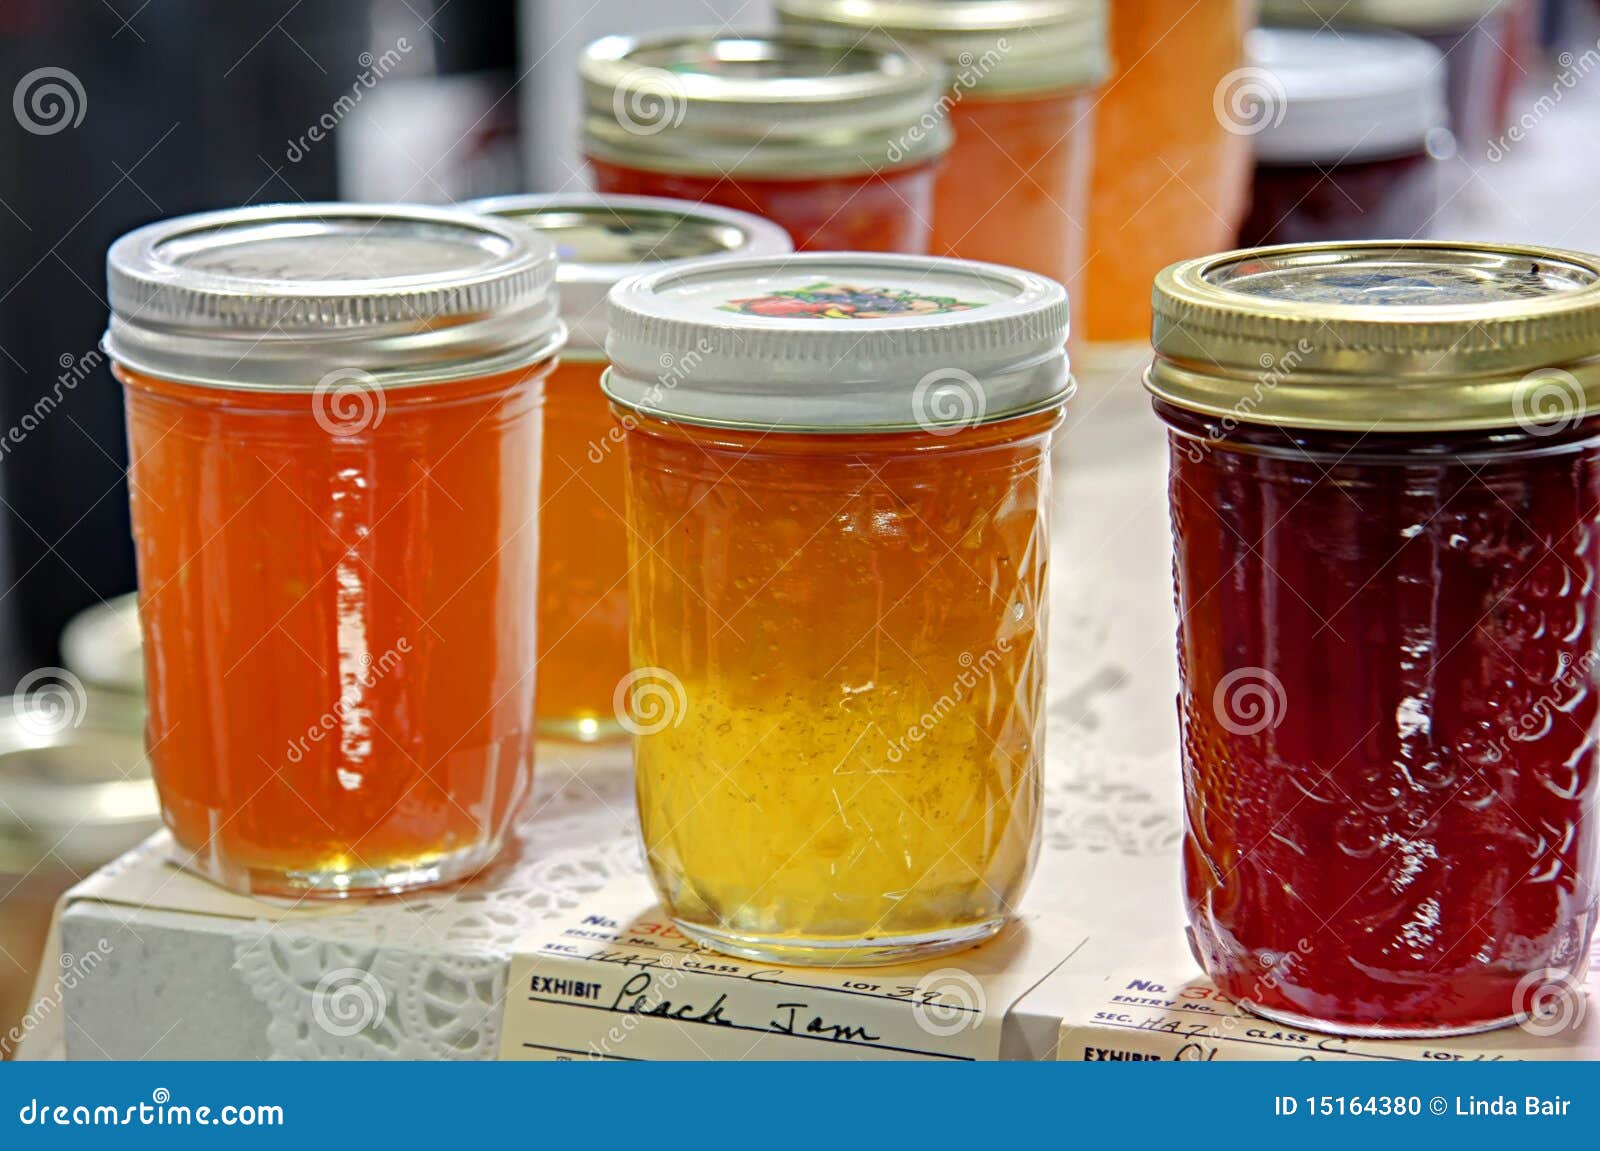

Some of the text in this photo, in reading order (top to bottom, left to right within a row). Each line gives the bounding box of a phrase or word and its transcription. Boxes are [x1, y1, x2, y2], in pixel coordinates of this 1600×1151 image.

[682, 960, 741, 974] CLASS
[842, 980, 881, 992] LOT
[530, 974, 602, 1001] EXHIBIT
[769, 1002, 881, 1042] Jam
[1111, 994, 1216, 1013] ENTRY No.
[1094, 1010, 1133, 1024] SEC.
[1245, 1028, 1310, 1043] CLASS
